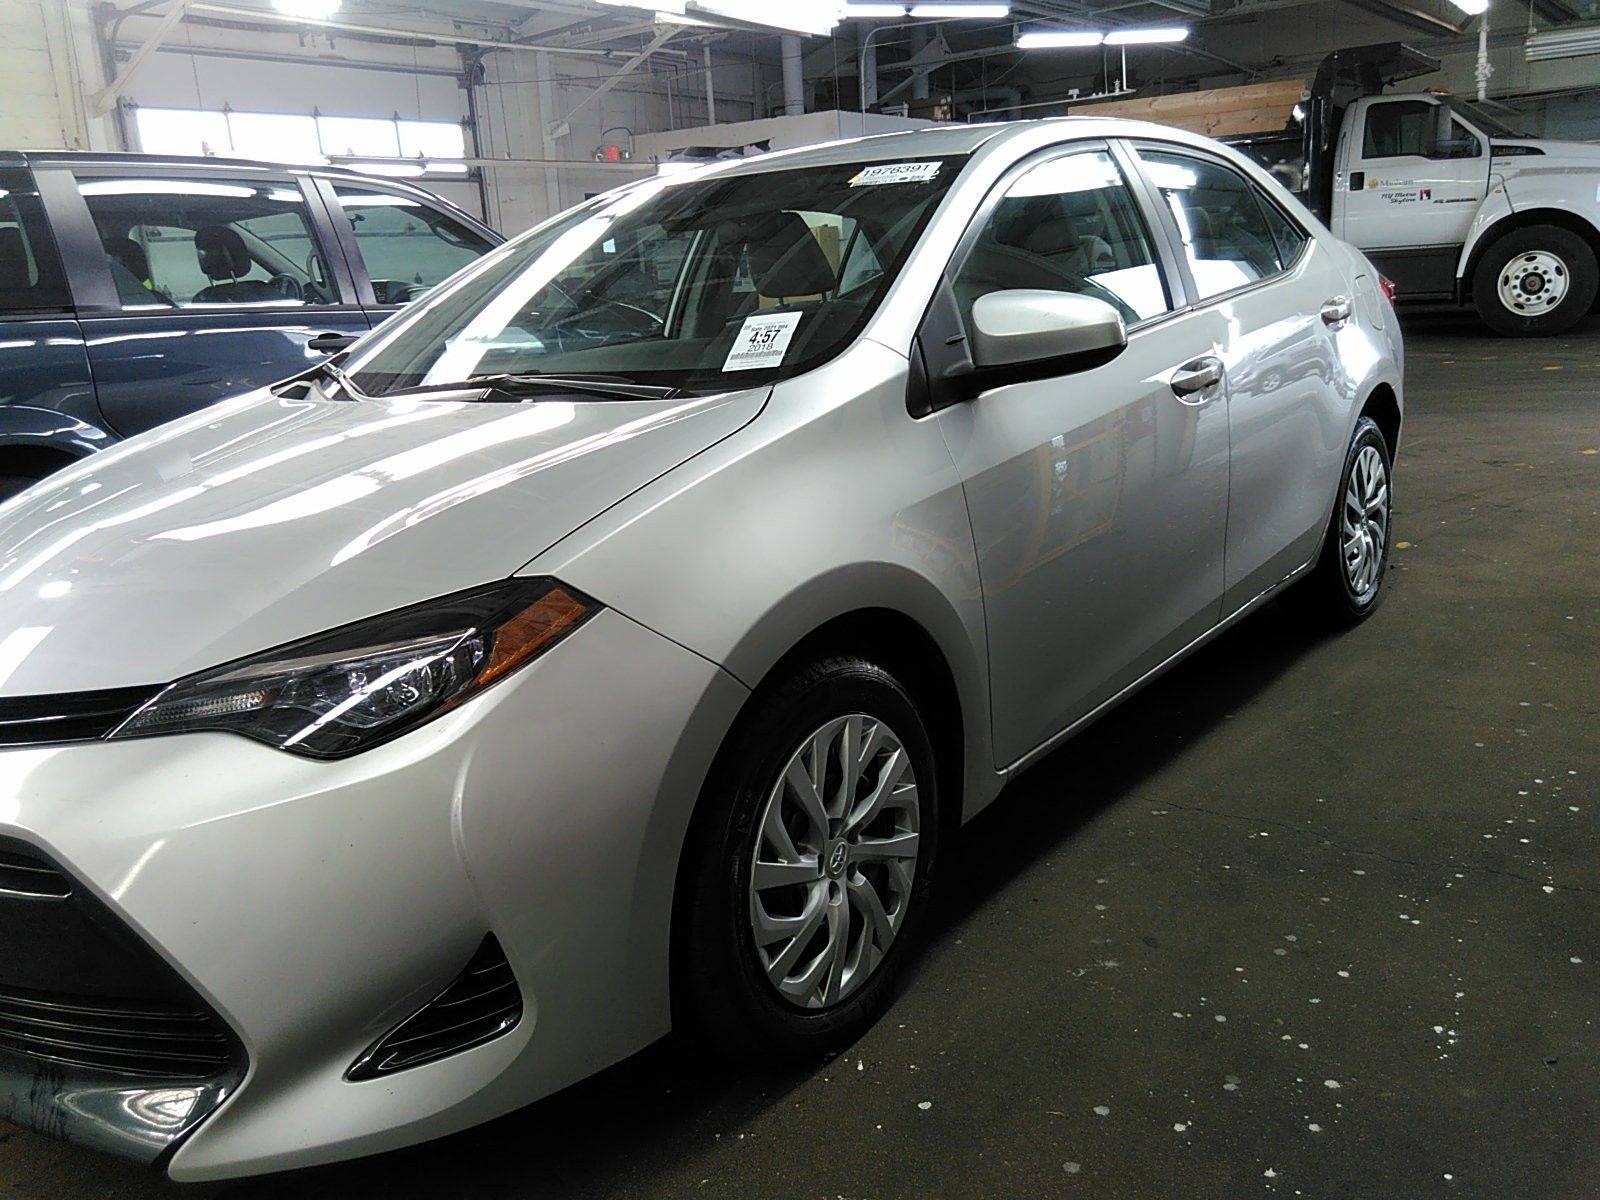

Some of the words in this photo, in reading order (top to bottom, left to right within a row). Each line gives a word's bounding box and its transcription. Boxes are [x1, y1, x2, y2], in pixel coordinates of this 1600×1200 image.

[864, 164, 930, 177] 1978391
[749, 329, 781, 344] 4:57
[747, 343, 773, 352] 2018
